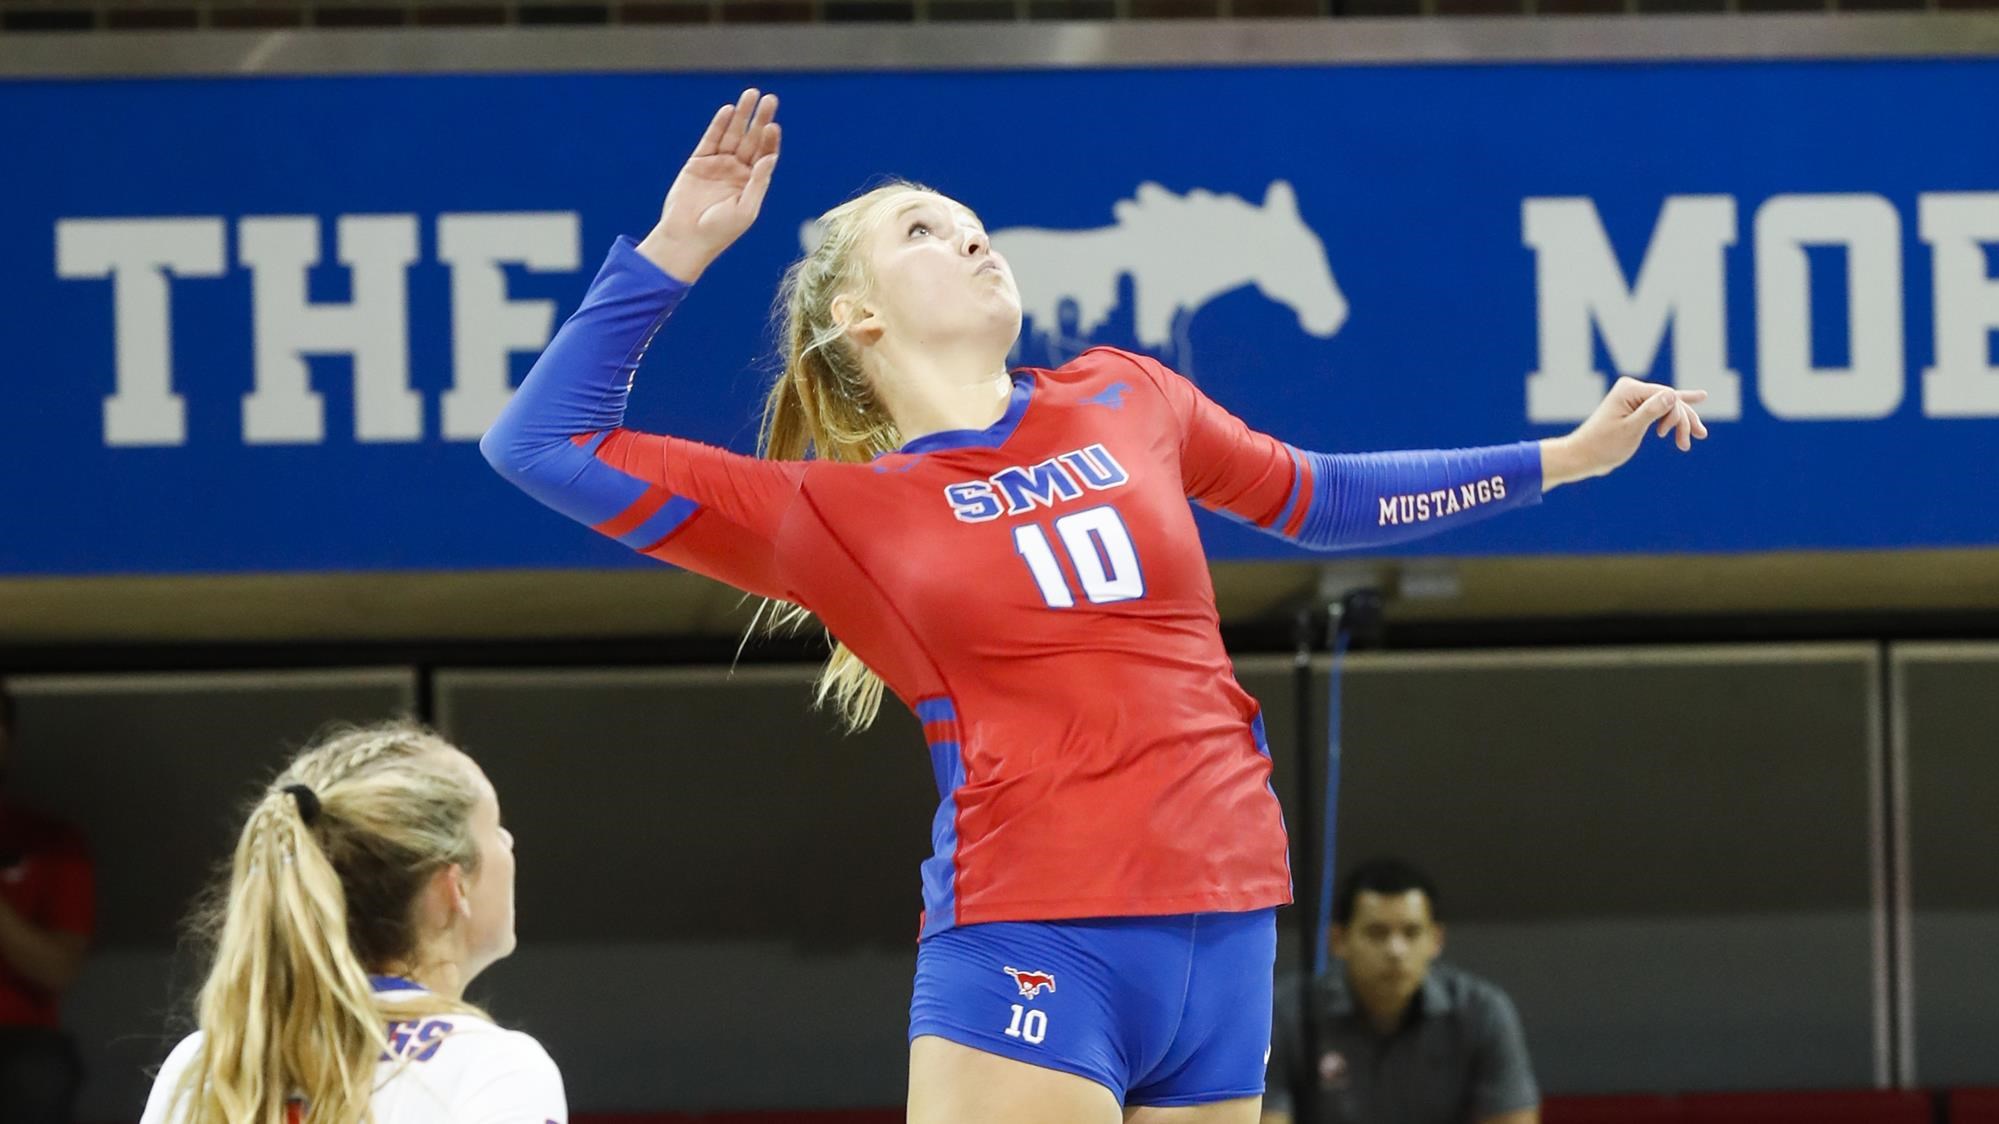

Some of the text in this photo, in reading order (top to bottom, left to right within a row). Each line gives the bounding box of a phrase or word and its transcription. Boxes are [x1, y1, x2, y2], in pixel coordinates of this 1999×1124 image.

[55, 212, 581, 446] THE
[944, 443, 1129, 523] SMU
[1378, 475, 1507, 526] MUSTANGS
[1011, 504, 1147, 610] 10
[1004, 1004, 1048, 1044] 10
